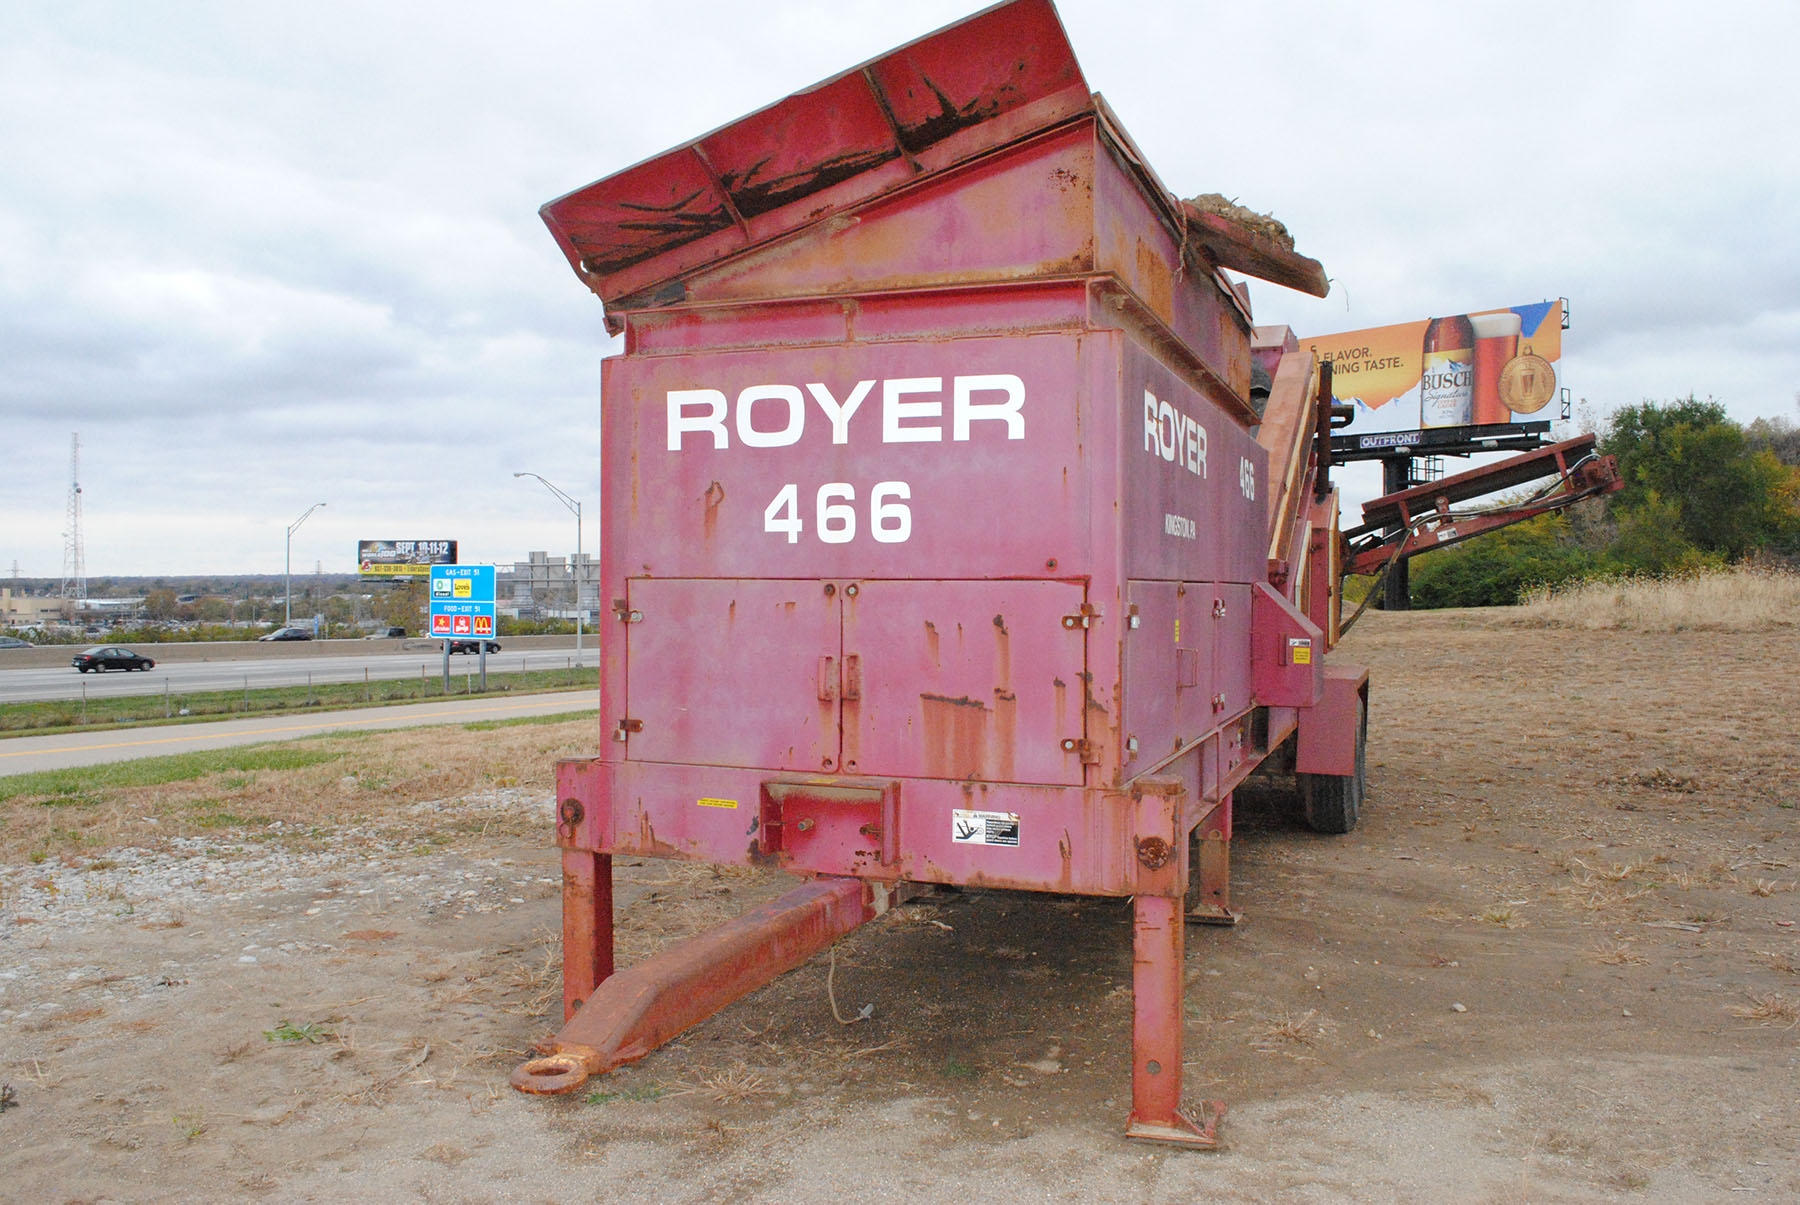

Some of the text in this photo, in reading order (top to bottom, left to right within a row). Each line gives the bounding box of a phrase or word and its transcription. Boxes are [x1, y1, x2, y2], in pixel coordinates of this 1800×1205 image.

[1323, 347, 1372, 362] FLAVOR.
[1332, 357, 1404, 376] NING TASTE.
[1423, 371, 1472, 391] BUSCH
[666, 373, 1026, 452] ROYER
[1144, 388, 1208, 480] ROYER
[1362, 433, 1419, 447] OUTFRONT
[1239, 455, 1255, 502] 466
[764, 480, 912, 544] 466
[395, 541, 416, 555] SEPT
[474, 605, 481, 613] 51
